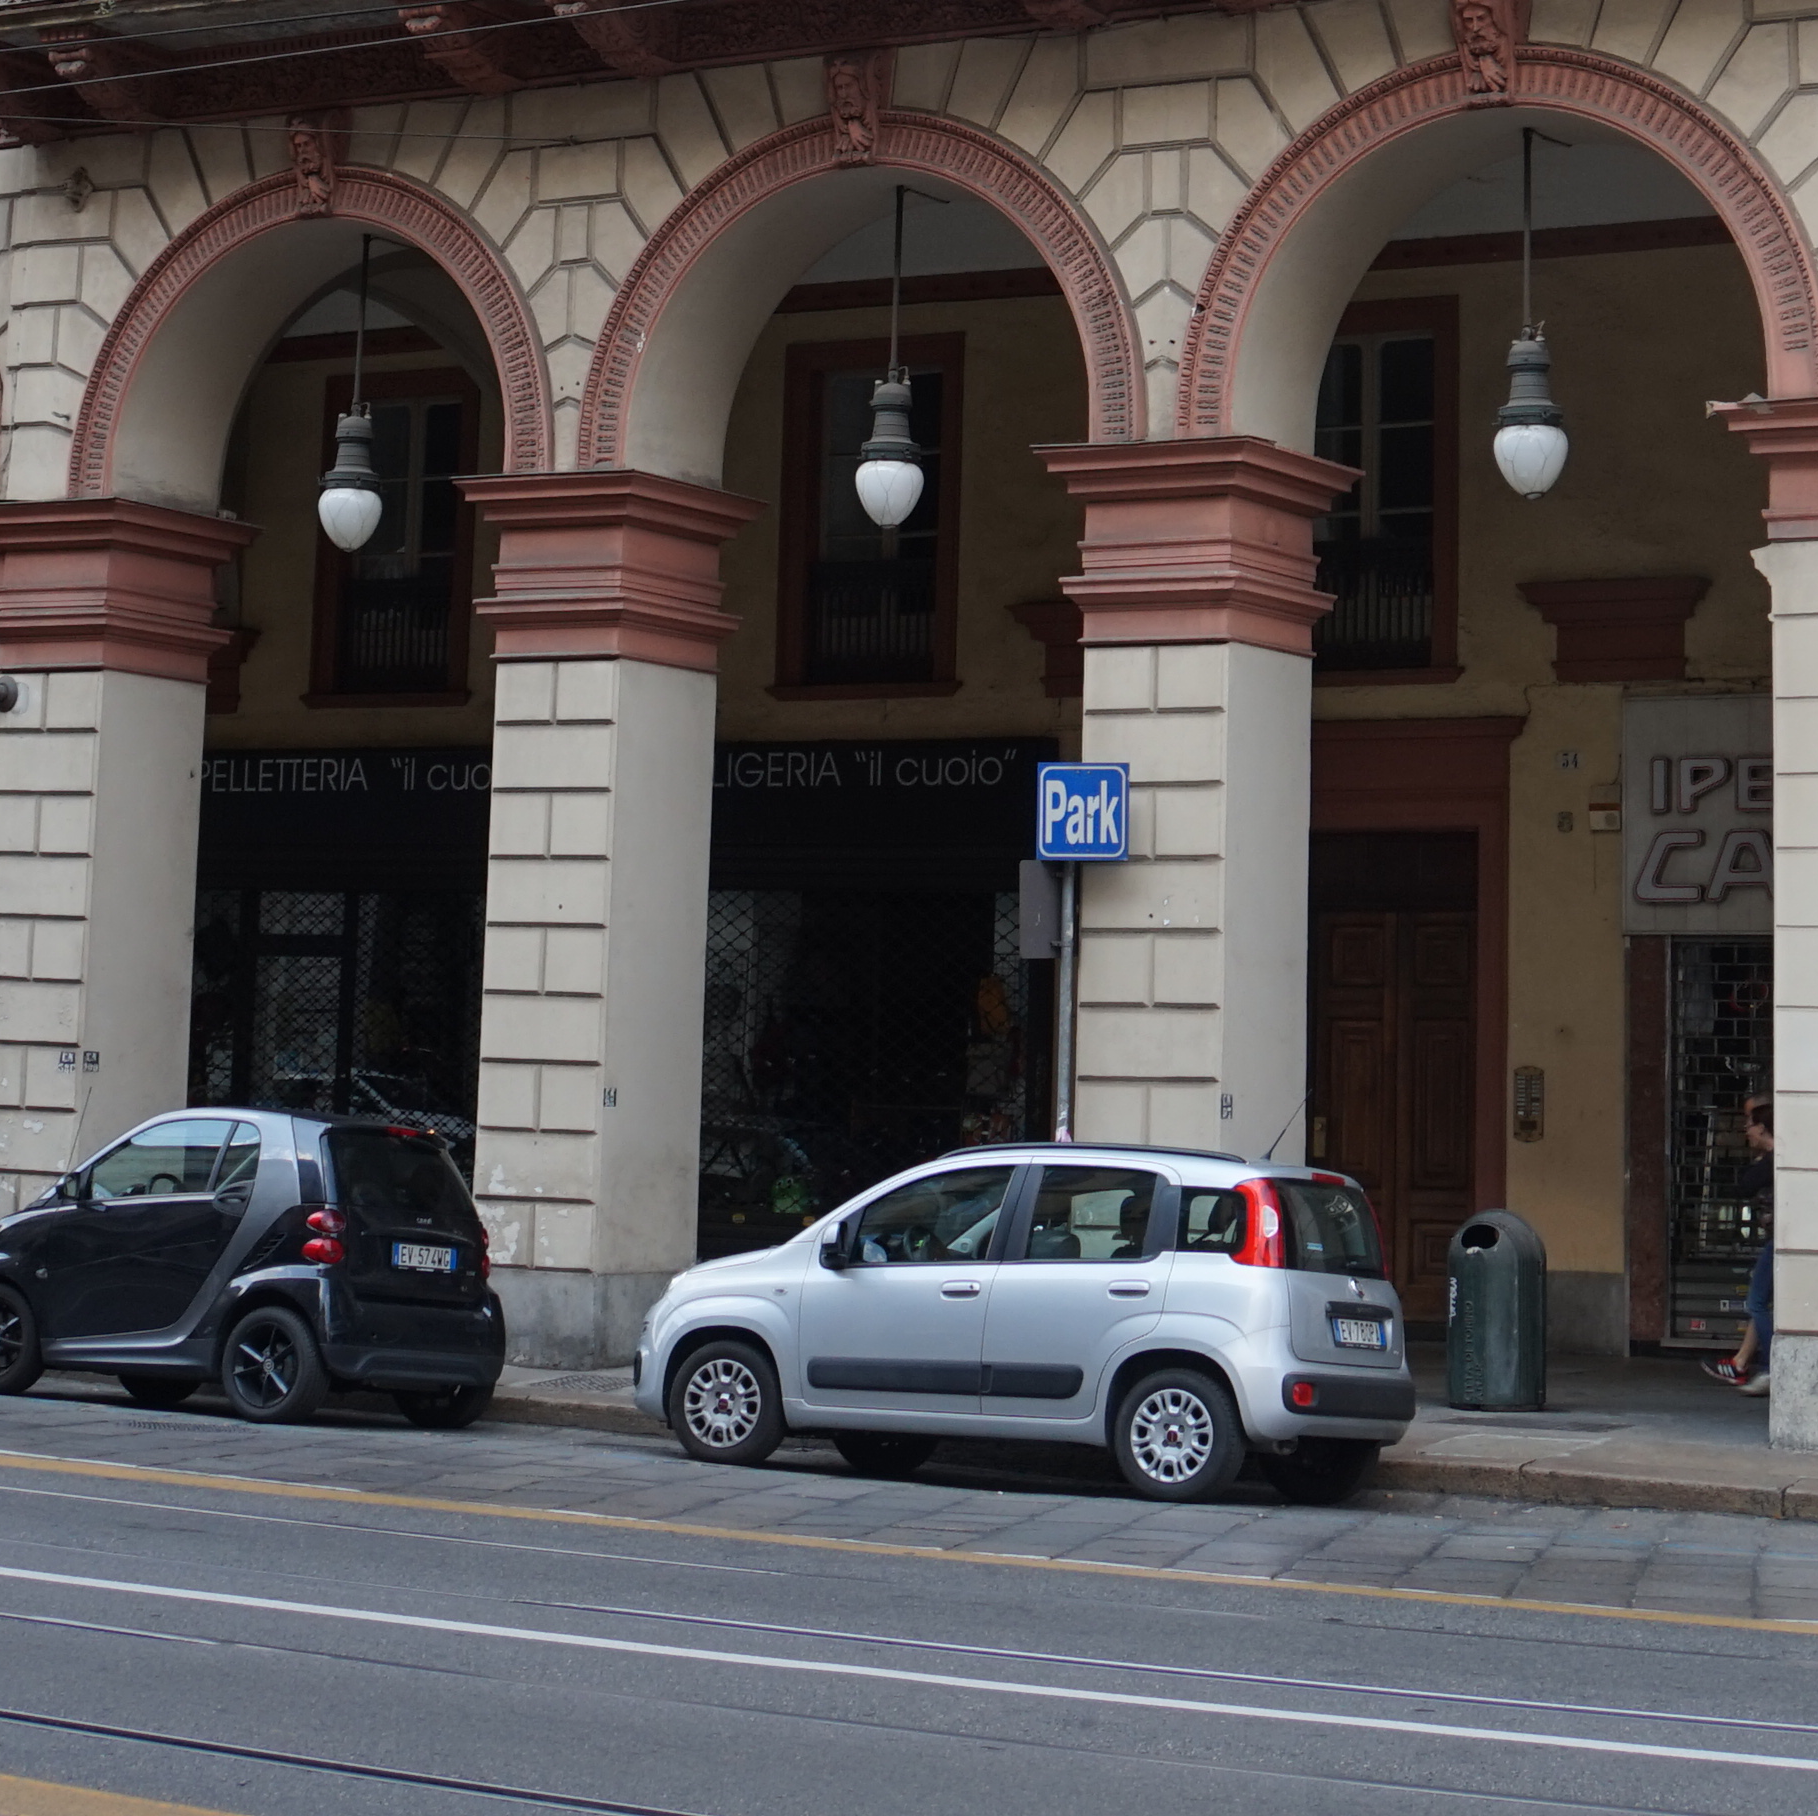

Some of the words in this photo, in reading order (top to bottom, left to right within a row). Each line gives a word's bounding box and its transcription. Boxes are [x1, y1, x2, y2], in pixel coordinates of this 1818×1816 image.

[1045, 779, 1119, 844] Park
[1651, 757, 1774, 812] IPE
[1635, 830, 1774, 901] CA
[401, 1246, 413, 1264] EV
